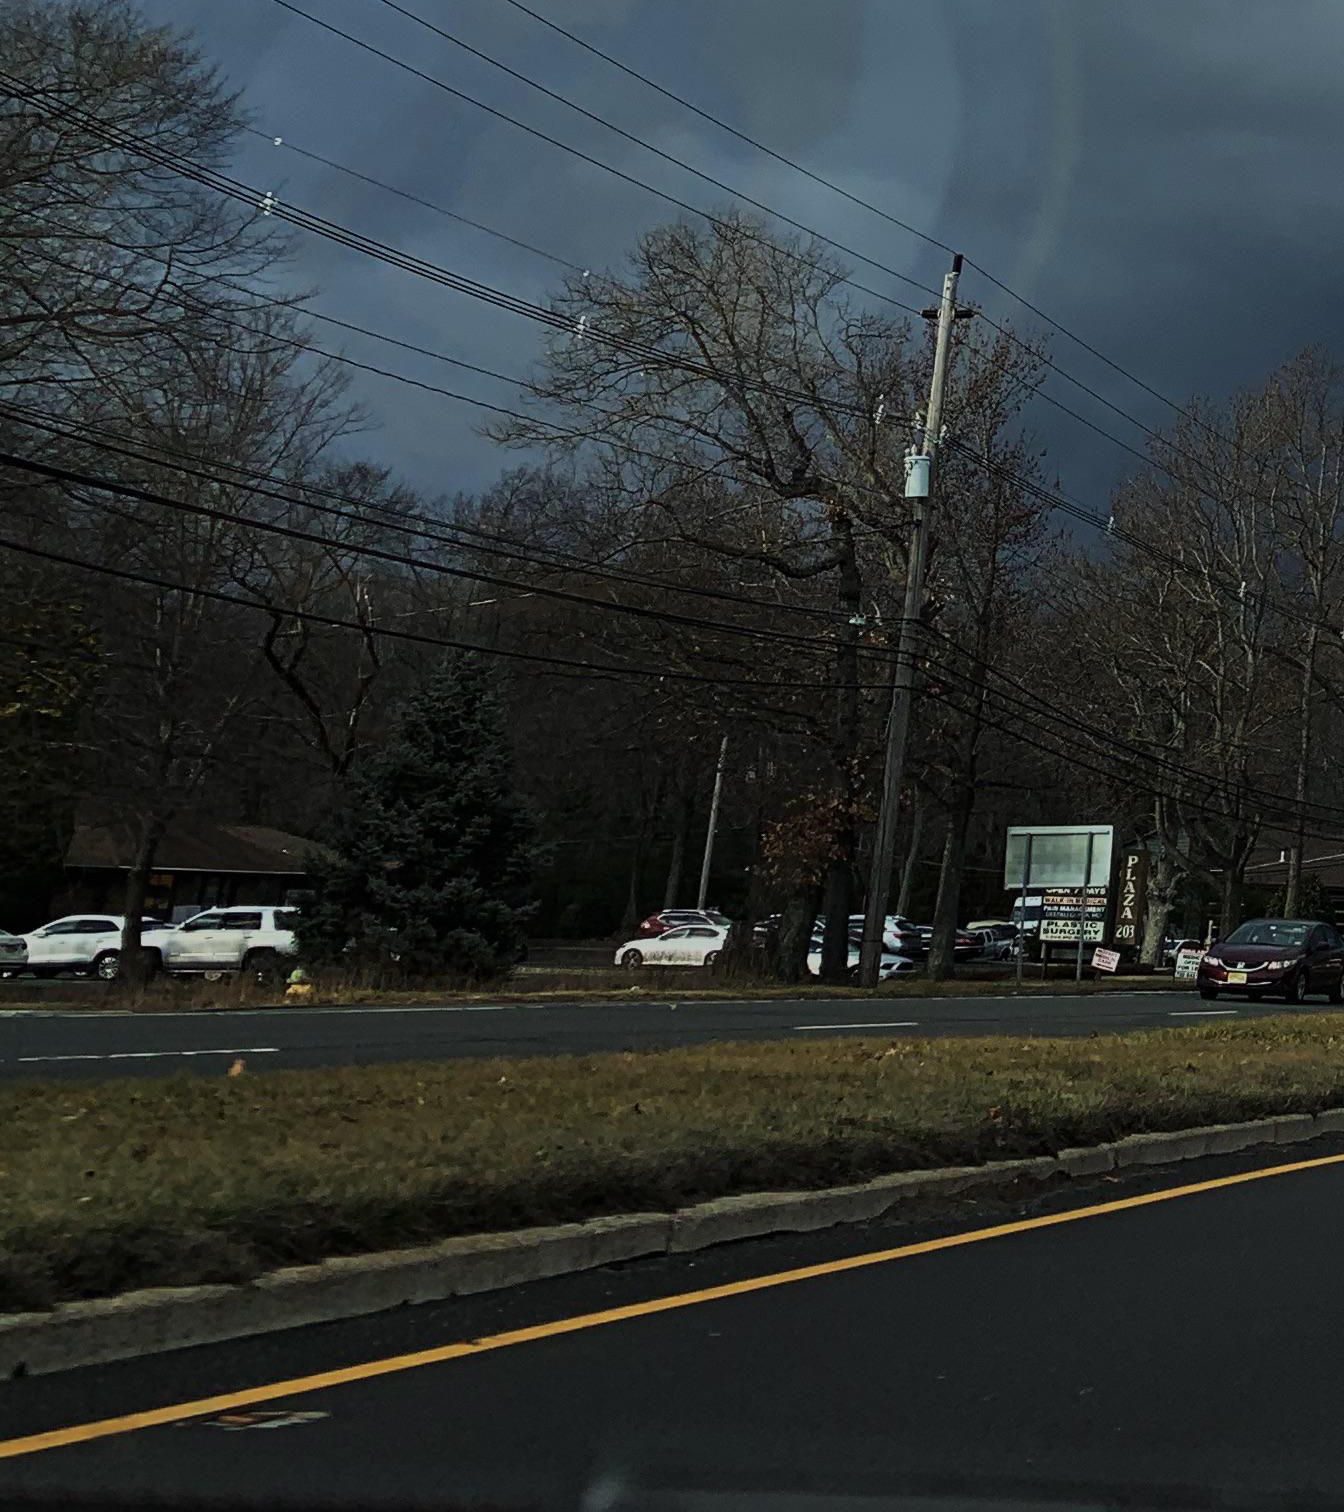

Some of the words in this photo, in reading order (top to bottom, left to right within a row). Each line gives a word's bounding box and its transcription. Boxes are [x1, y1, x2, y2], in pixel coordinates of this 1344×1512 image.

[1120, 855, 1139, 919] PLAZA
[1042, 928, 1100, 936] SURGERY
[1115, 924, 1135, 938] 203
